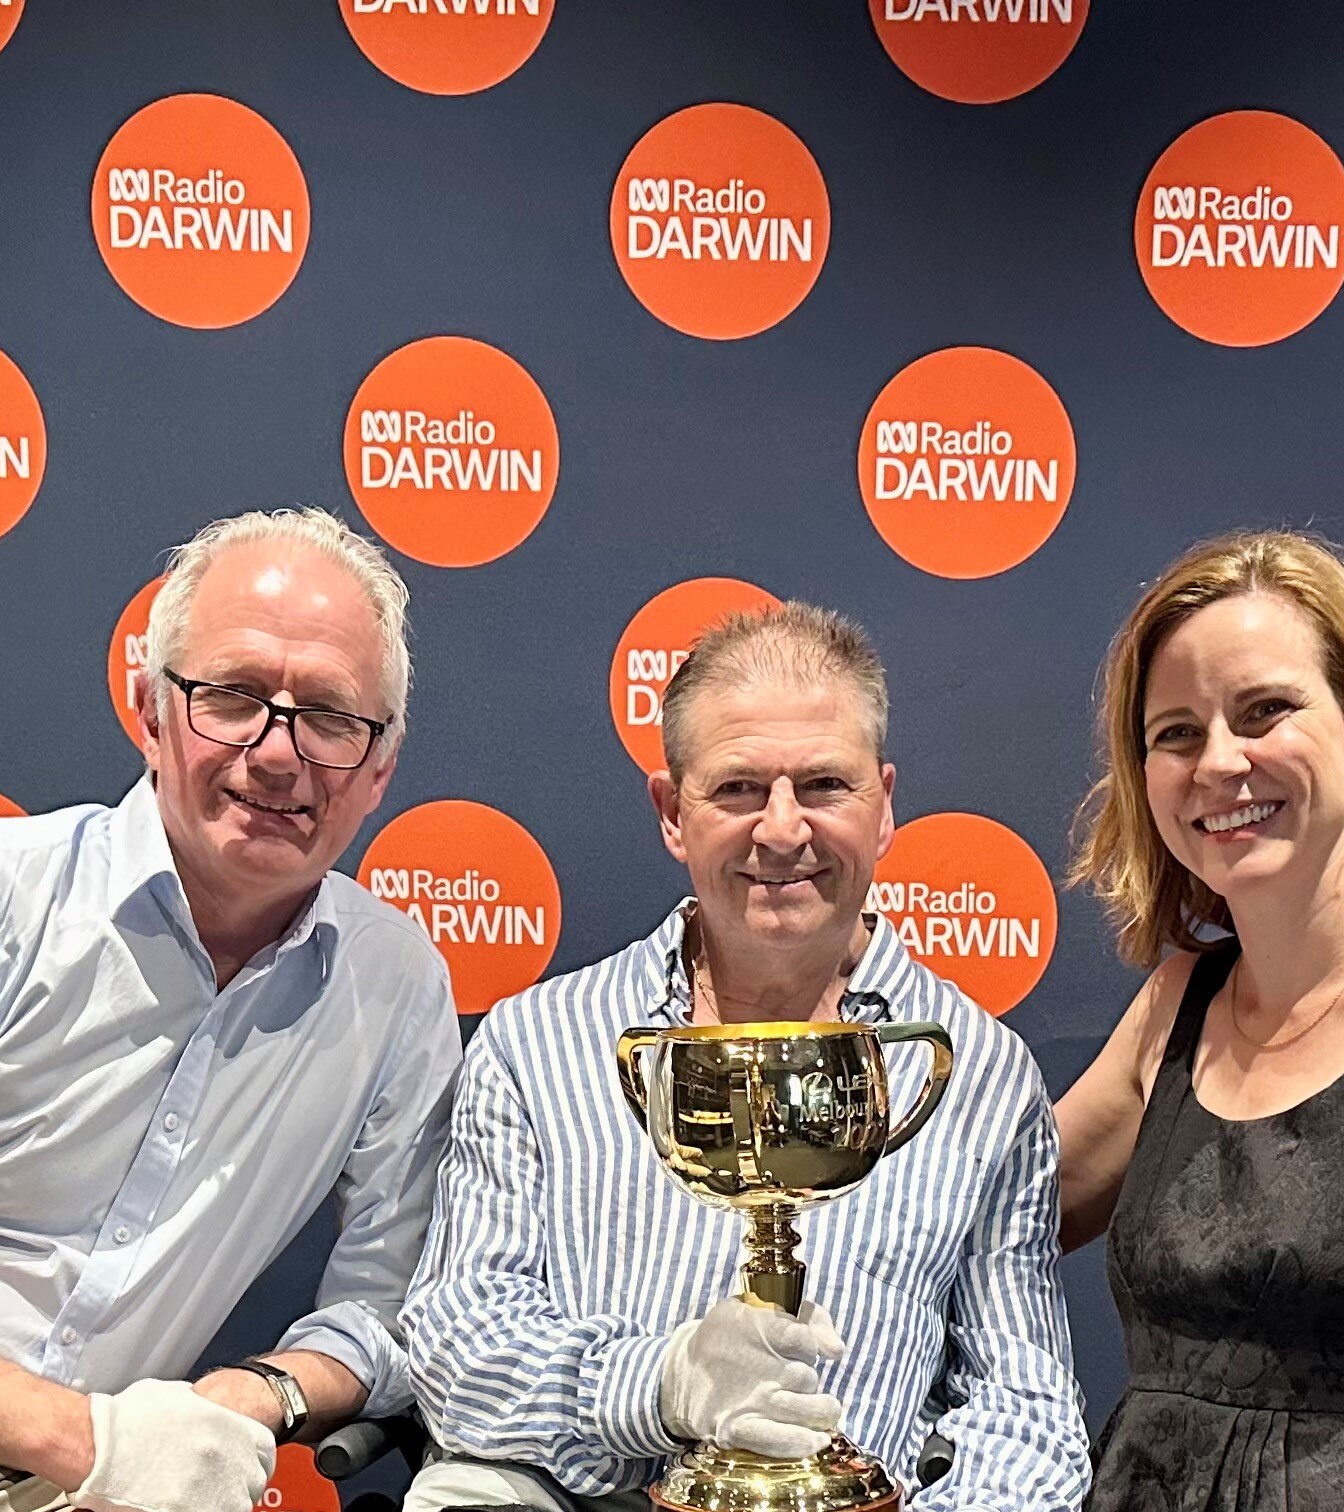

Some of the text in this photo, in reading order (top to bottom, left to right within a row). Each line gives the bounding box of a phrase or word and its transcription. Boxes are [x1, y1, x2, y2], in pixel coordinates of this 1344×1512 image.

[153, 168, 246, 205] Radio
[673, 178, 766, 214] Radio
[1198, 186, 1293, 222] Radio
[109, 205, 293, 253] DARWIN
[628, 215, 812, 262] DARWIN
[1151, 223, 1339, 269] DARWIN
[404, 410, 496, 445] Radio
[920, 421, 1013, 456] Radio
[361, 445, 542, 492] DARWIN
[874, 456, 1058, 502] DARWIN
[412, 869, 501, 902] Radio
[907, 882, 997, 915] Radio
[406, 903, 545, 945] RWIN
[897, 916, 1041, 957] ARWIN
